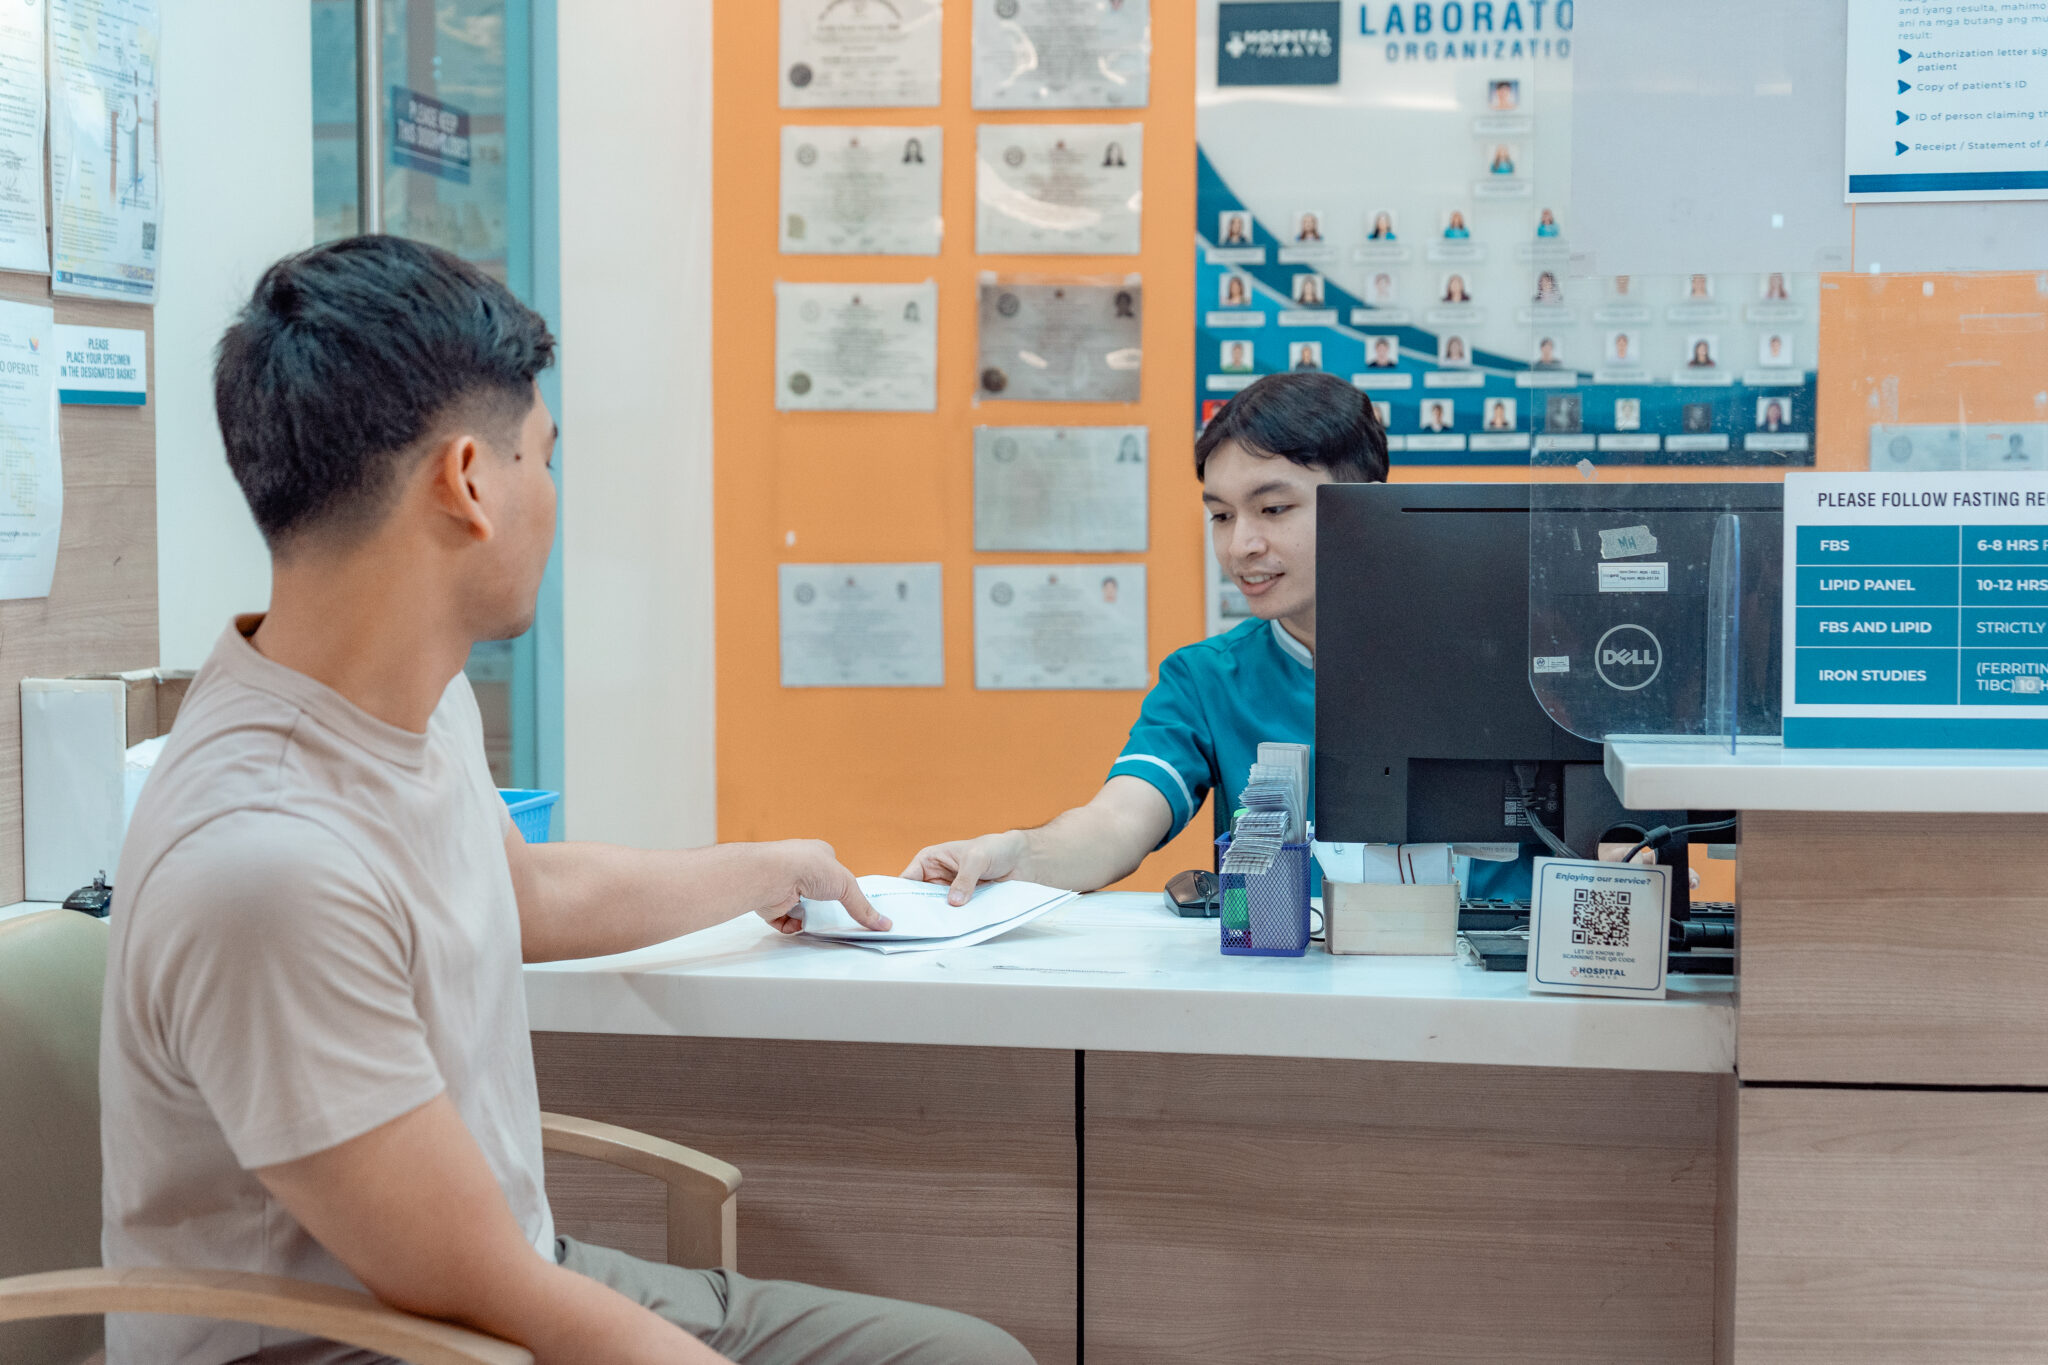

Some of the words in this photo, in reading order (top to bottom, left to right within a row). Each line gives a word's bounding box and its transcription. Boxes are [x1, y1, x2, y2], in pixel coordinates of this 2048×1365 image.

[1899, 7, 1919, 15] and
[1922, 6, 1953, 16] iyang
[2001, 2, 2047, 11] mahimo
[1360, 0, 1573, 35] LABORATO
[1899, 20, 1915, 28] ani
[1936, 19, 1960, 28] mga
[1963, 17, 2004, 26] butang
[2007, 16, 2028, 25] ang
[1244, 29, 1332, 44] HOSPITAL
[1898, 32, 1933, 40] result:
[1385, 38, 1571, 62] ORGANIZATIO
[1917, 48, 1994, 59] Authorization
[1998, 48, 2028, 57] letter
[1917, 63, 1958, 72] patient
[1917, 83, 1945, 92] Copy
[1948, 82, 1959, 91] of
[1962, 80, 2012, 91] patient's
[2015, 80, 2028, 89] ID
[1915, 113, 1928, 121] ID
[1931, 112, 1942, 121] of
[1945, 112, 1983, 122] person
[1986, 110, 2035, 120] claiming
[1915, 143, 1957, 152] Receipt
[1968, 141, 2026, 151] Statement
[2030, 140, 2041, 149] of
[88, 338, 109, 350] PLEASE
[66, 351, 84, 364] PLACE
[86, 352, 101, 365] YOUR
[103, 353, 131, 366] SPECIMEN
[7, 361, 39, 376] OPERATE
[61, 366, 67, 377] IN
[68, 366, 79, 378] THE
[81, 366, 114, 379] DESIGNATED
[1818, 492, 1876, 507] PLEASE
[1882, 492, 1947, 507] FOLLOW
[1953, 491, 2020, 507] FASTING
[2026, 491, 2048, 506] RE
[1820, 539, 1850, 552] FBS
[1977, 539, 2003, 552] 6-8
[2006, 539, 2040, 552] HRS
[1820, 579, 1860, 591] LIPID
[1864, 579, 1915, 591] PANEL
[1976, 579, 2014, 591] 10-12
[2017, 579, 2048, 591] HRS
[1819, 621, 1848, 633] FBS
[1852, 621, 1888, 633] AND
[1891, 621, 1932, 633] LIPID
[1976, 621, 2046, 634] STRICTLY
[1603, 649, 1655, 666] DELL
[1819, 670, 1858, 682] IRON
[1861, 670, 1927, 682] STUDIES
[1976, 679, 2016, 693] TIBC)
[1555, 872, 1595, 883] Enjoying
[1614, 876, 1651, 885] service?
[1579, 966, 1626, 977] HOSPITAL
